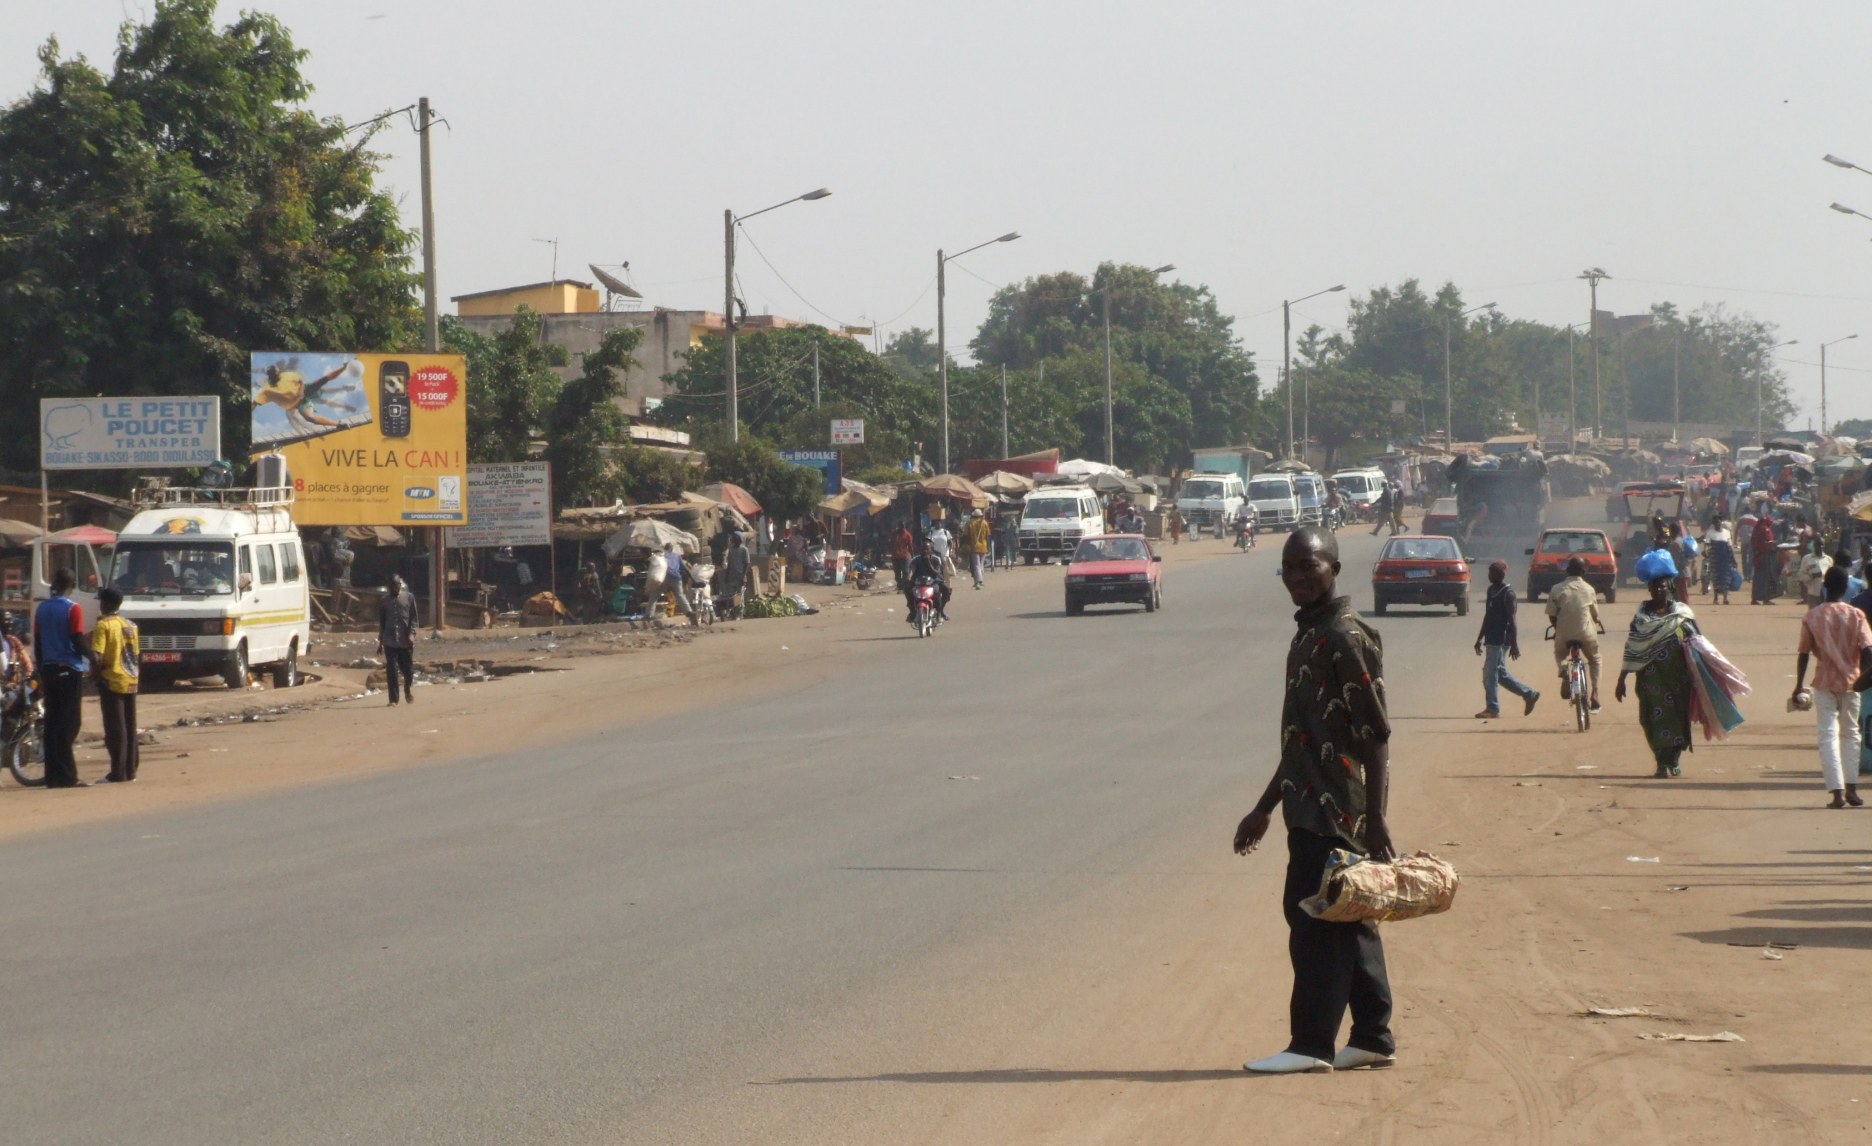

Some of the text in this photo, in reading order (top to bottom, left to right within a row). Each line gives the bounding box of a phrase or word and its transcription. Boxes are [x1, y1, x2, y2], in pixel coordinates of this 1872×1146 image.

[417, 392, 448, 400] 15 000F
[102, 401, 212, 418] LE PETIT
[107, 419, 208, 436] POUCET
[162, 449, 216, 462] DIOULASSO
[322, 449, 367, 467] VIVE
[374, 449, 398, 467] LA
[405, 450, 449, 468] CAN
[794, 451, 838, 460] BOUAKE
[485, 472, 525, 480] AKWABA
[294, 478, 390, 496] 8 places à gagner
[409, 488, 431, 497] MTN
